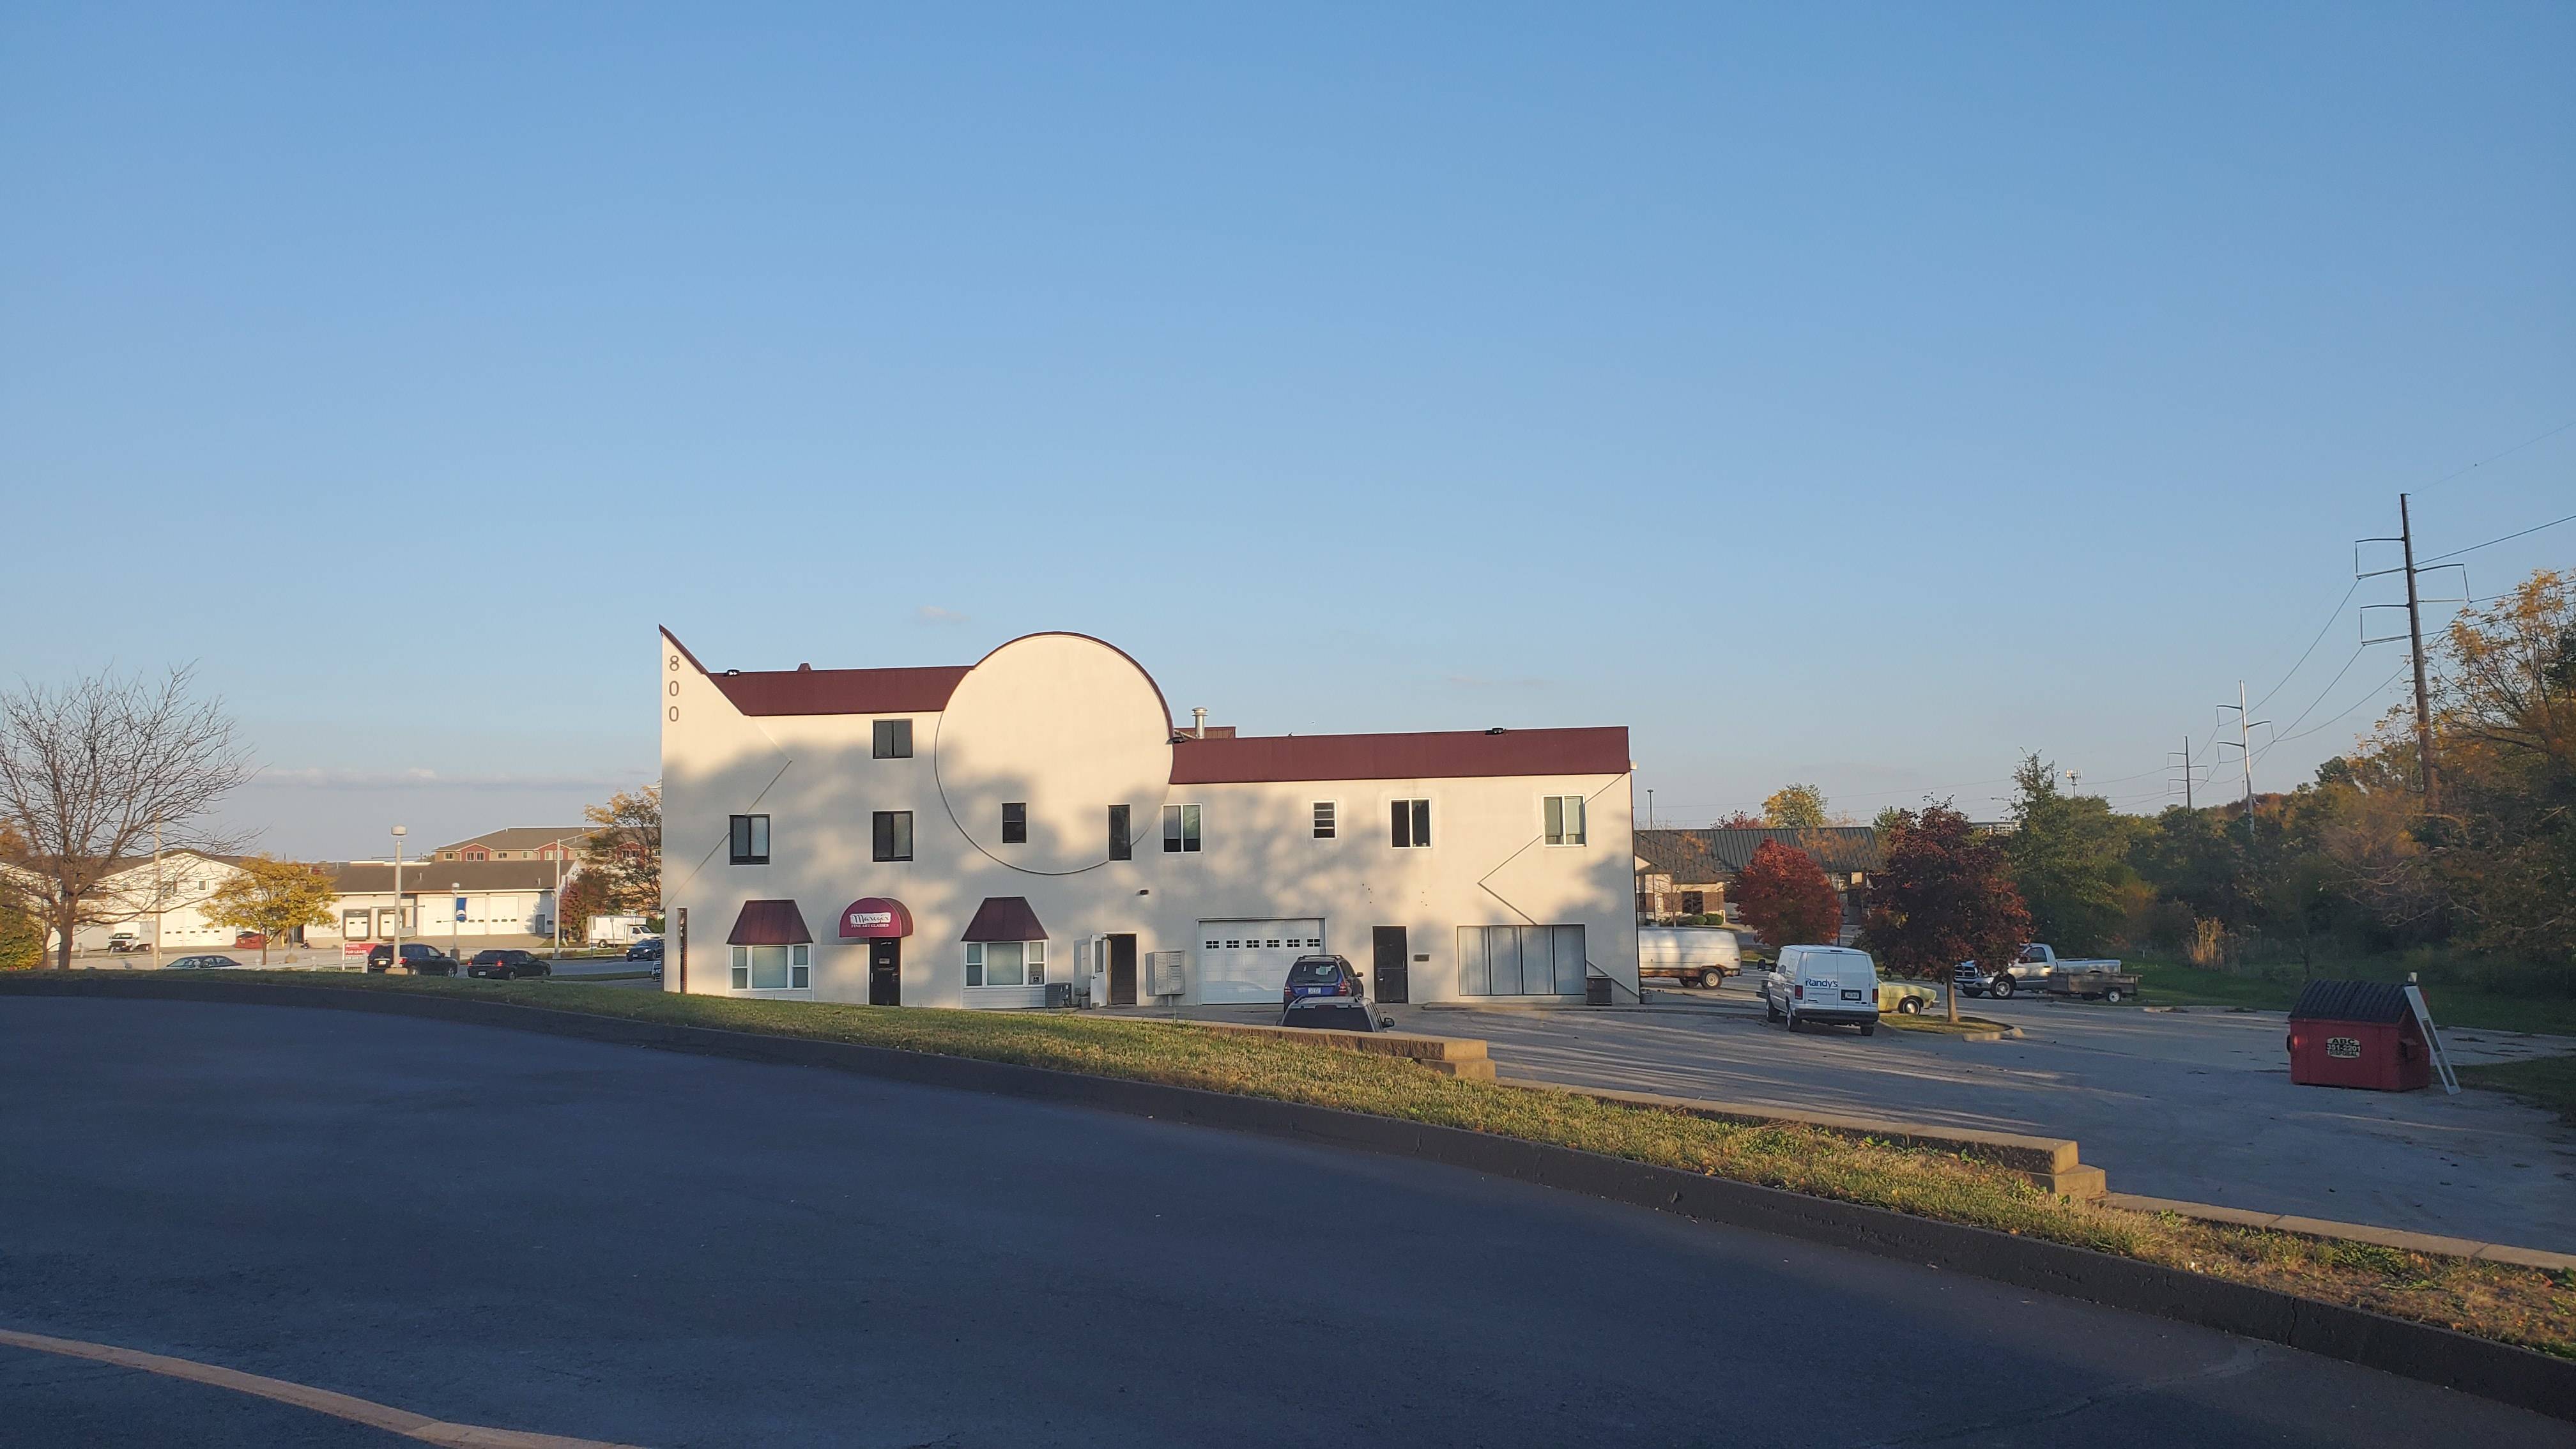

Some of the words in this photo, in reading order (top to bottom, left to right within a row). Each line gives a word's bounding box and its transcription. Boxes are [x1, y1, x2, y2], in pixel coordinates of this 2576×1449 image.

[669, 655, 680, 722] 800
[1805, 978, 1838, 988] Randy's
[2327, 1044, 2361, 1052] 351-2201
